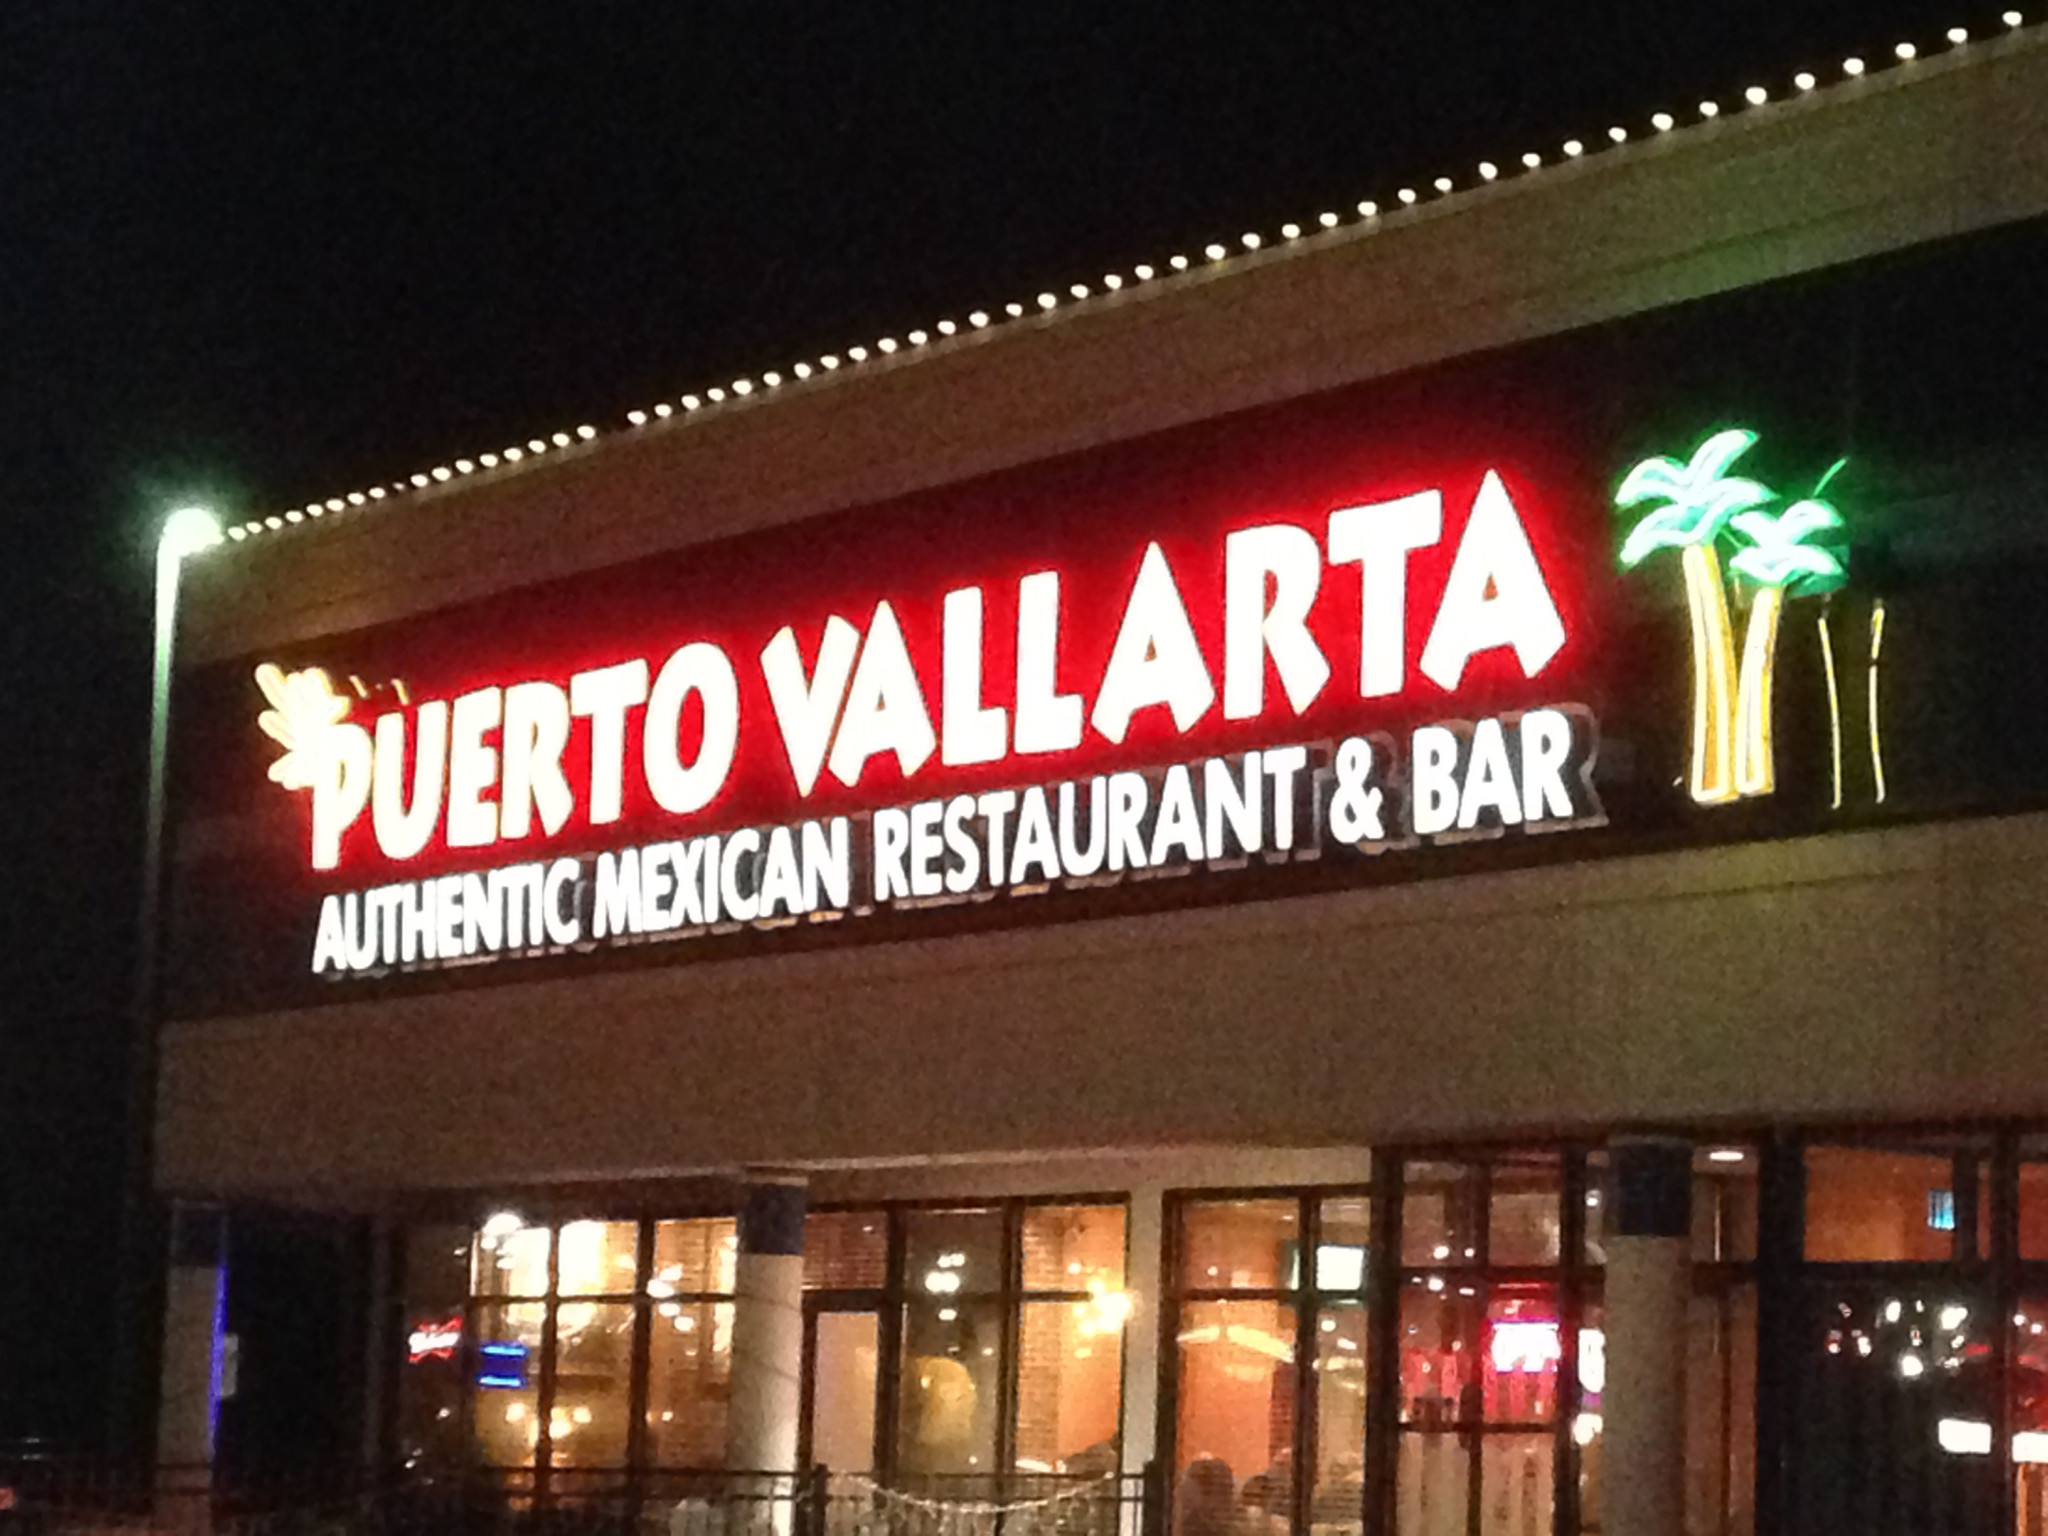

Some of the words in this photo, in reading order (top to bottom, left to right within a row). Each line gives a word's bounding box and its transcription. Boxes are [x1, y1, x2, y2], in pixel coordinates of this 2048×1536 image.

[311, 641, 740, 869] PUERTO
[760, 467, 1567, 797] VALLARTA
[312, 857, 580, 974] AUTHENTIC
[592, 815, 850, 938] MEXICAN
[873, 745, 1307, 902] RESTAURANT
[1328, 736, 1385, 844] &
[1412, 708, 1573, 835] BAR
